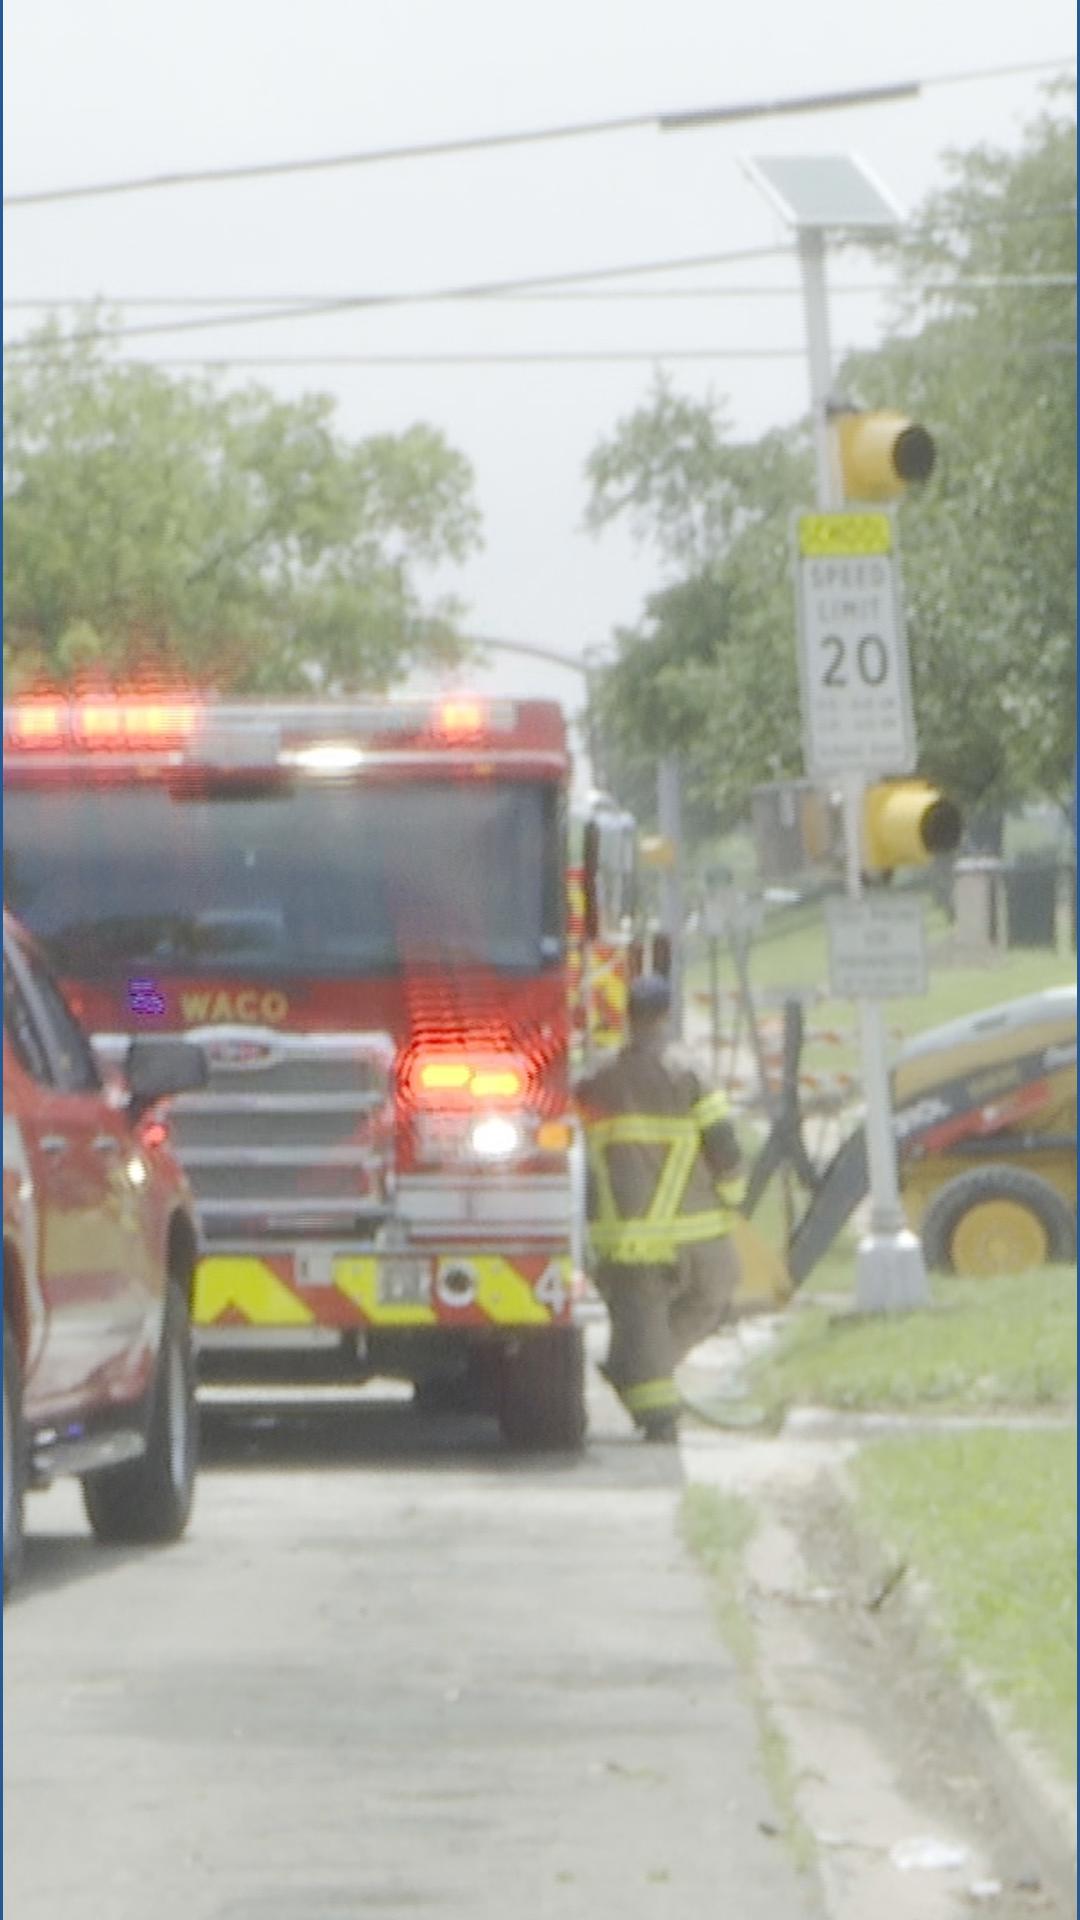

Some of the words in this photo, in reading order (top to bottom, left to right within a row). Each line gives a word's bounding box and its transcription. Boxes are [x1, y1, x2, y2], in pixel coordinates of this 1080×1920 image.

[811, 561, 886, 588] SPEED
[818, 598, 882, 623] LIMIT
[821, 633, 888, 687] 20
[181, 988, 290, 1022] WACO
[536, 1262, 568, 1314] 4
